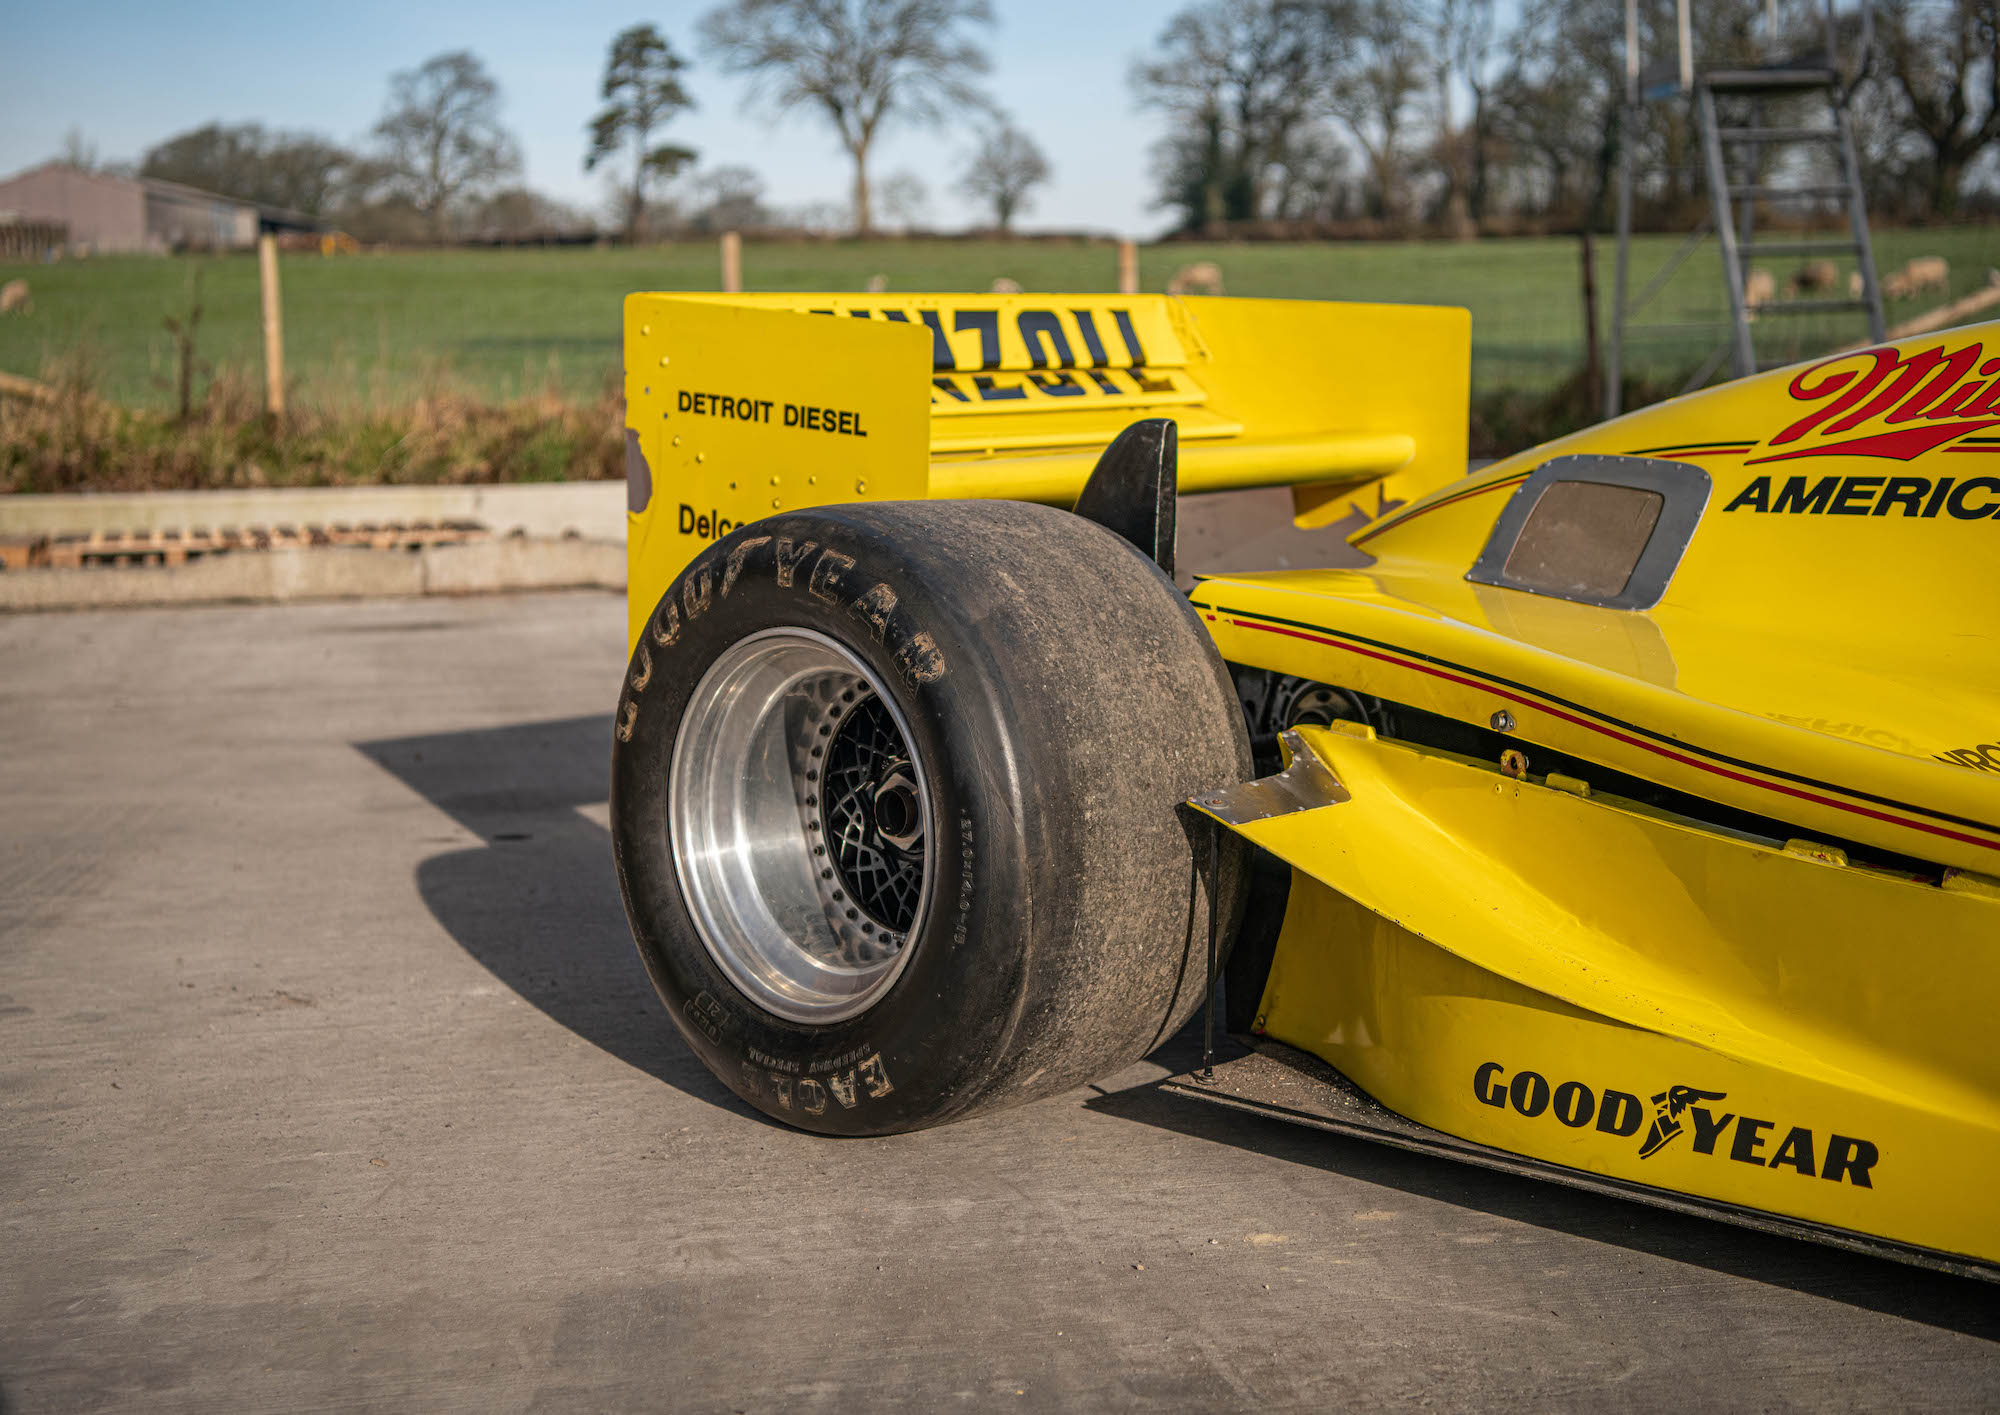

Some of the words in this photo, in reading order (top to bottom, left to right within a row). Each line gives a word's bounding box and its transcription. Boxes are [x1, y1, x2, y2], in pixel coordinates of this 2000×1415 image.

[677, 390, 774, 423] DETROIT
[783, 404, 868, 437] DIESEL
[1722, 475, 2000, 521] AMERIC
